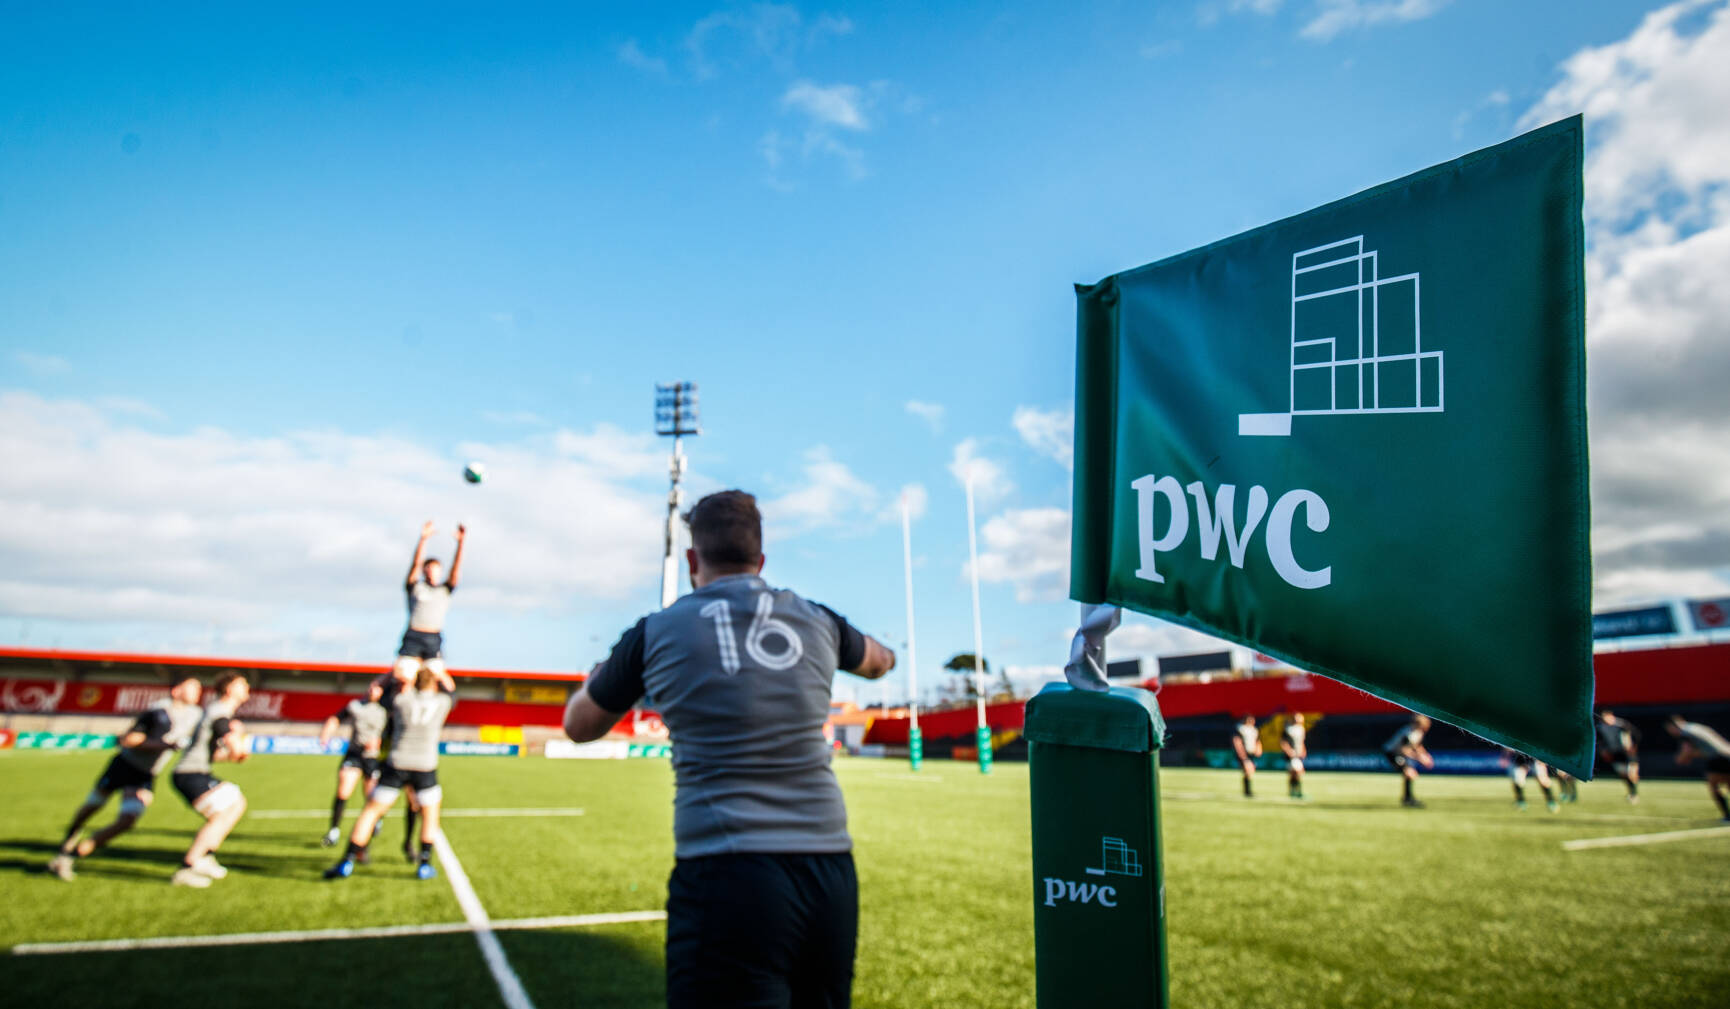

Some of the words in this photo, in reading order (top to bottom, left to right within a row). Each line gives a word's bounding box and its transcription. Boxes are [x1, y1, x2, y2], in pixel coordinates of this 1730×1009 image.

[1131, 474, 1331, 589] pwc
[699, 592, 803, 676] 16
[409, 700, 438, 725] 17
[1043, 877, 1118, 908] pwc
